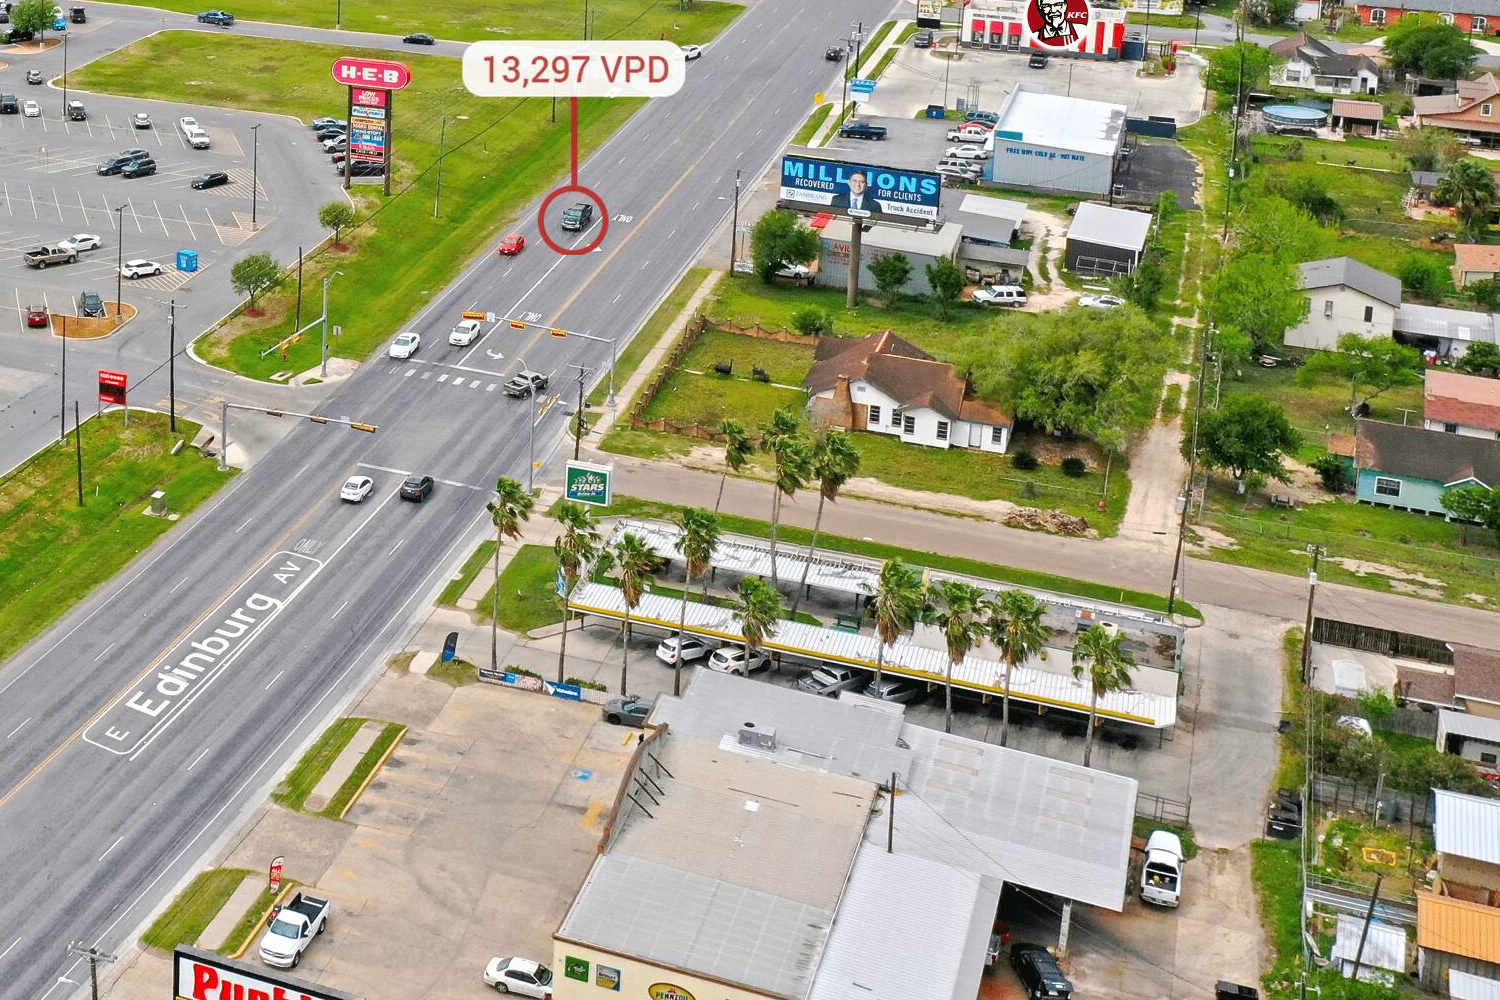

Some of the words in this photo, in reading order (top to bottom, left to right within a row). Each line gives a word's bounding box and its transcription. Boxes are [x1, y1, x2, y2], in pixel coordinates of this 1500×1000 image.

[795, 178, 834, 190] RECOVERED
[878, 189, 891, 198] FOR
[893, 191, 921, 201] CLIENTS
[887, 203, 904, 212] Truck
[905, 206, 933, 215] Accident
[571, 483, 604, 492] STARS
